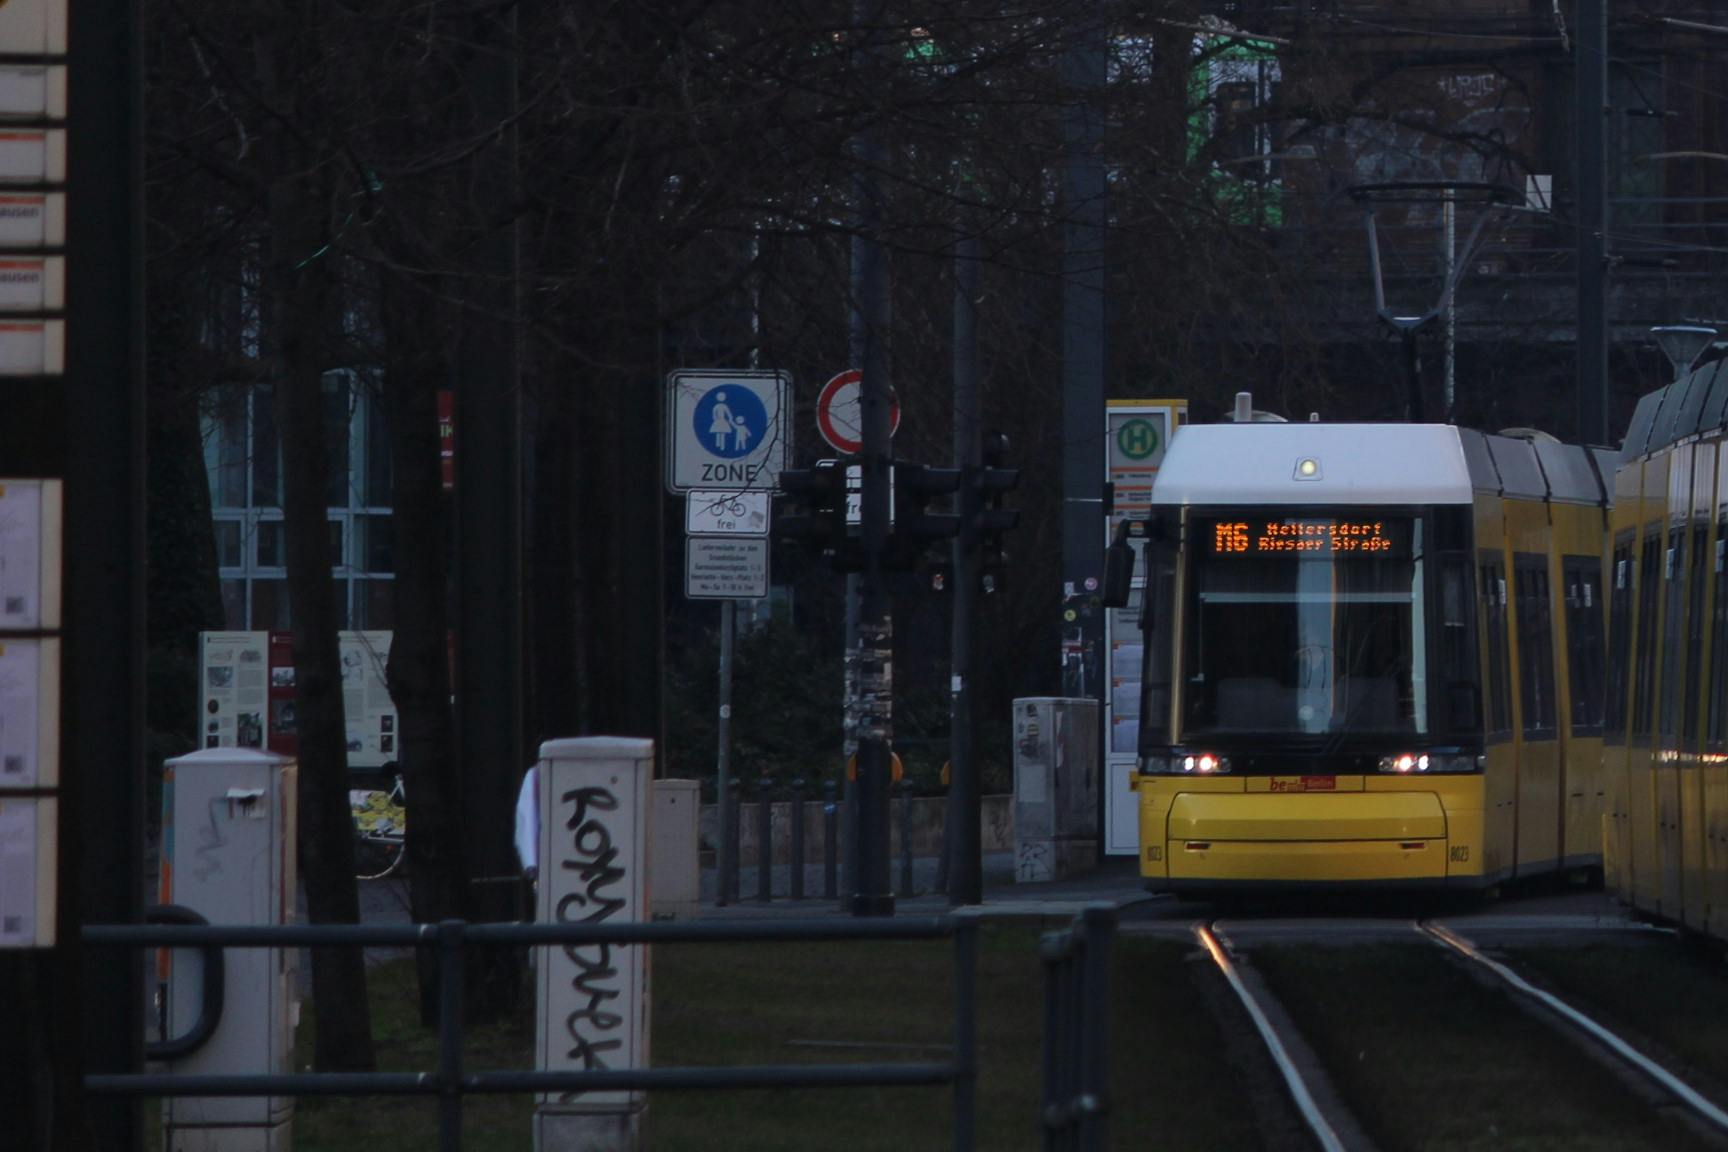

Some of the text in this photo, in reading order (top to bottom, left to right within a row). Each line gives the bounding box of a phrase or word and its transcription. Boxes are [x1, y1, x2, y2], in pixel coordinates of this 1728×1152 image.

[702, 464, 757, 482] ZONE
[717, 520, 736, 529] frei
[1216, 522, 1249, 552] M6
[1258, 536, 1391, 552] Riesaer Straße
